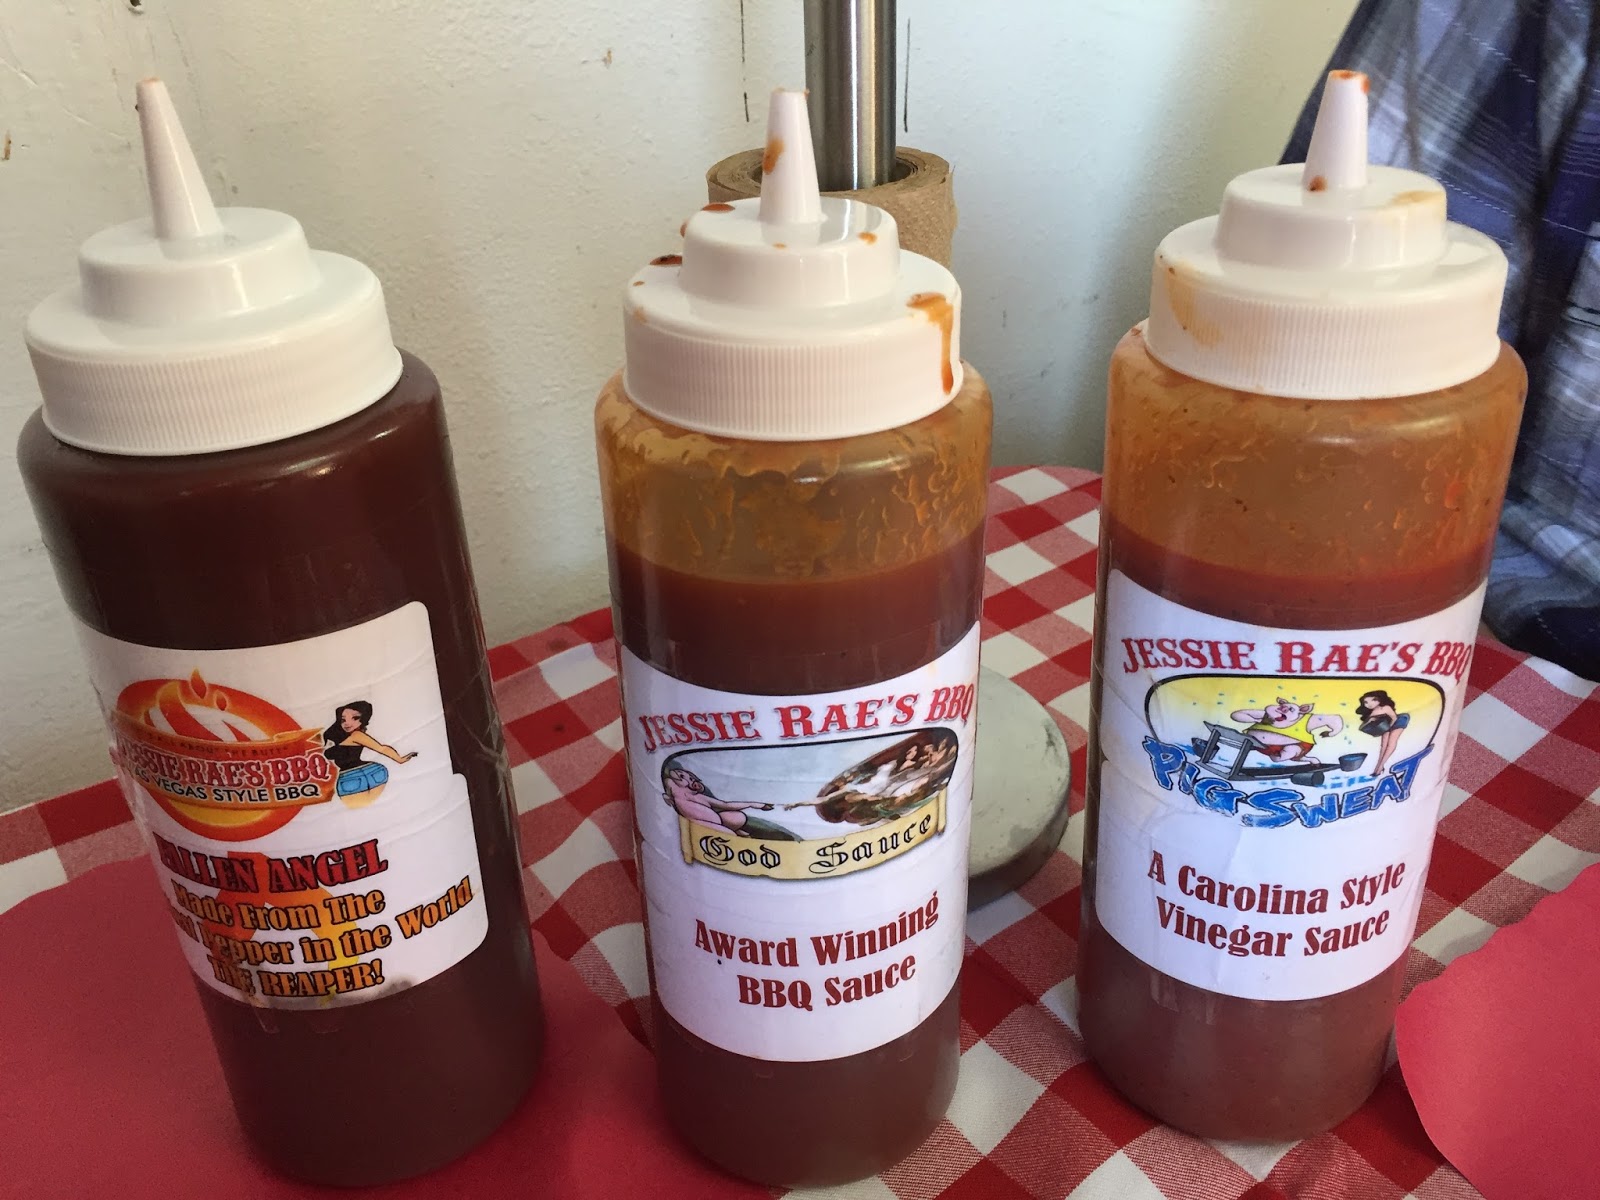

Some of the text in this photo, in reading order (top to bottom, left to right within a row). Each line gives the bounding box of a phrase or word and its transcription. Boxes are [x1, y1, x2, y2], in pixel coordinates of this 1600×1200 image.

[1121, 638, 1472, 686] JESSIE RAE'S BBQ
[639, 683, 975, 752] JESSIE RAE'S BBQ
[114, 738, 181, 782] ESSIE
[183, 758, 265, 788] RAE'S
[268, 754, 332, 786] BBQ
[152, 775, 208, 801] VEGAS
[213, 787, 270, 803] STYLE
[275, 783, 320, 800] BBQ
[268, 838, 389, 894] ANGEL
[699, 813, 933, 875] God Sauce
[170, 877, 235, 928] Made
[237, 901, 321, 931] From
[323, 889, 386, 926] The
[1147, 850, 1406, 916] A Carolina Style
[298, 936, 338, 964] in
[338, 923, 392, 958] the
[395, 874, 474, 940] World
[694, 890, 940, 968] Award Winning
[1156, 895, 1391, 958] Vinegar Sauce
[256, 957, 386, 999] REAPER!
[736, 954, 917, 1013] BBQ Sauce
